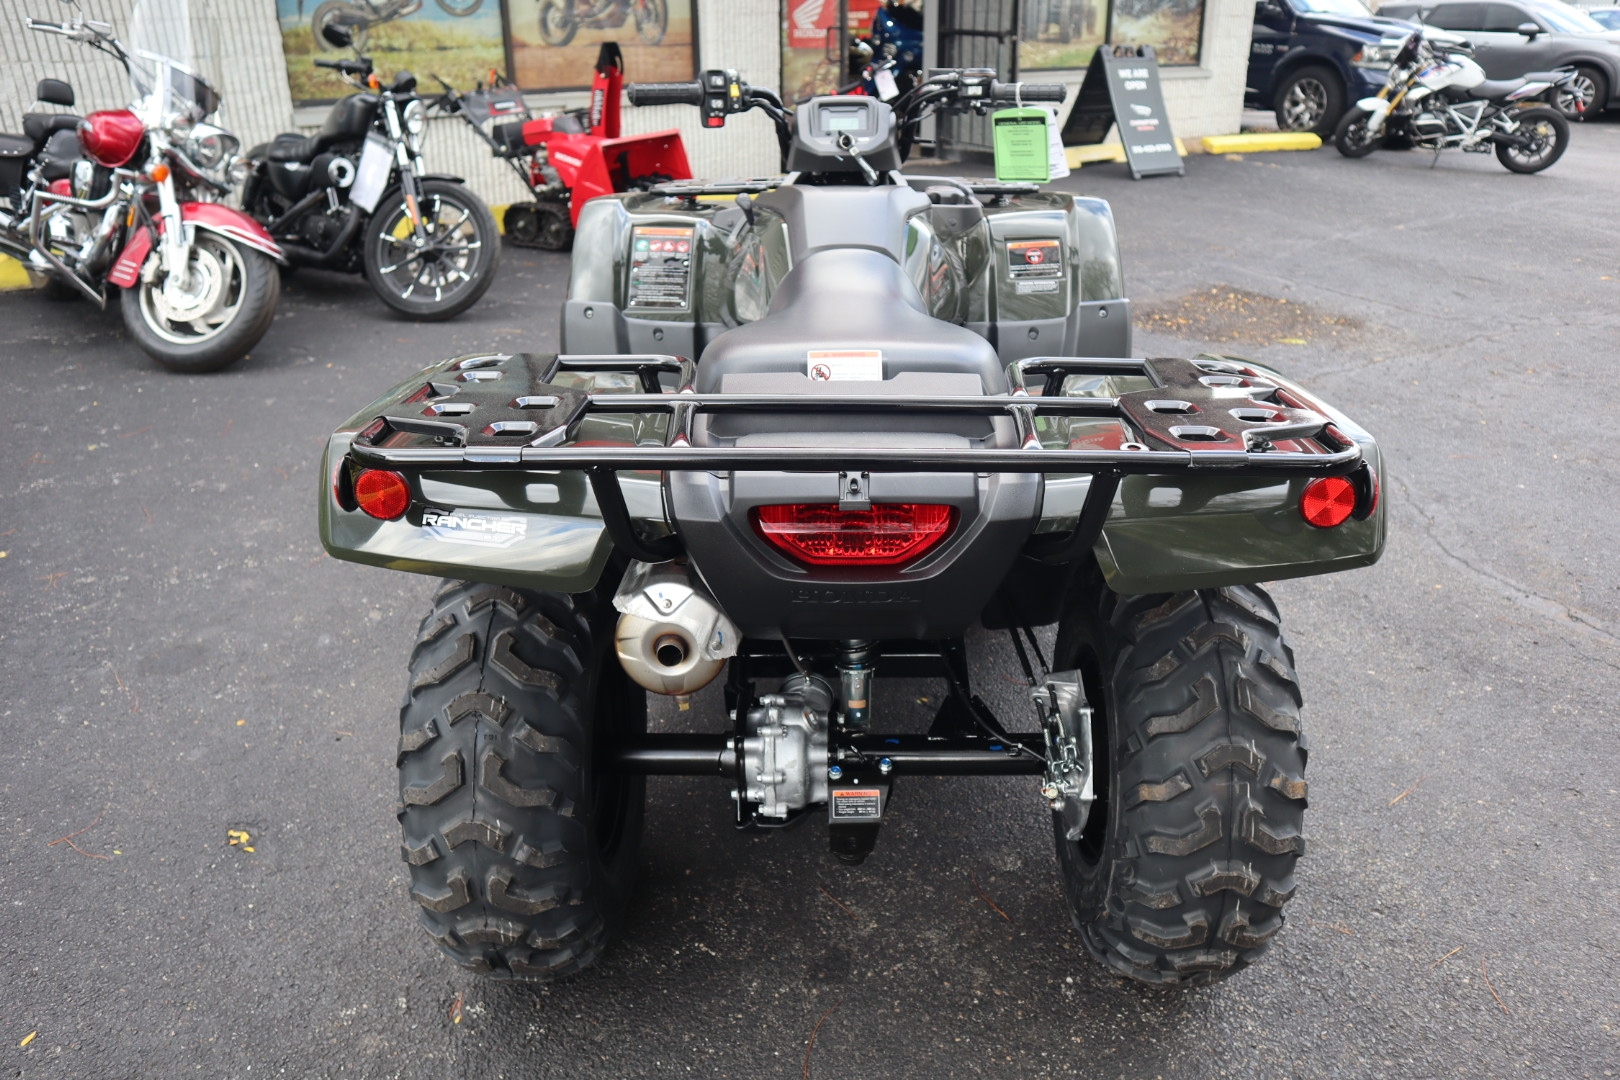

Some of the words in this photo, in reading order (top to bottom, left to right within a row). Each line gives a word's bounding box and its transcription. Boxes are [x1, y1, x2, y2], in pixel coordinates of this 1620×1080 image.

[1118, 68, 1132, 78] WE
[1132, 68, 1149, 78] ARE
[1124, 80, 1147, 90] OPEN
[422, 514, 527, 536] RANCHER
